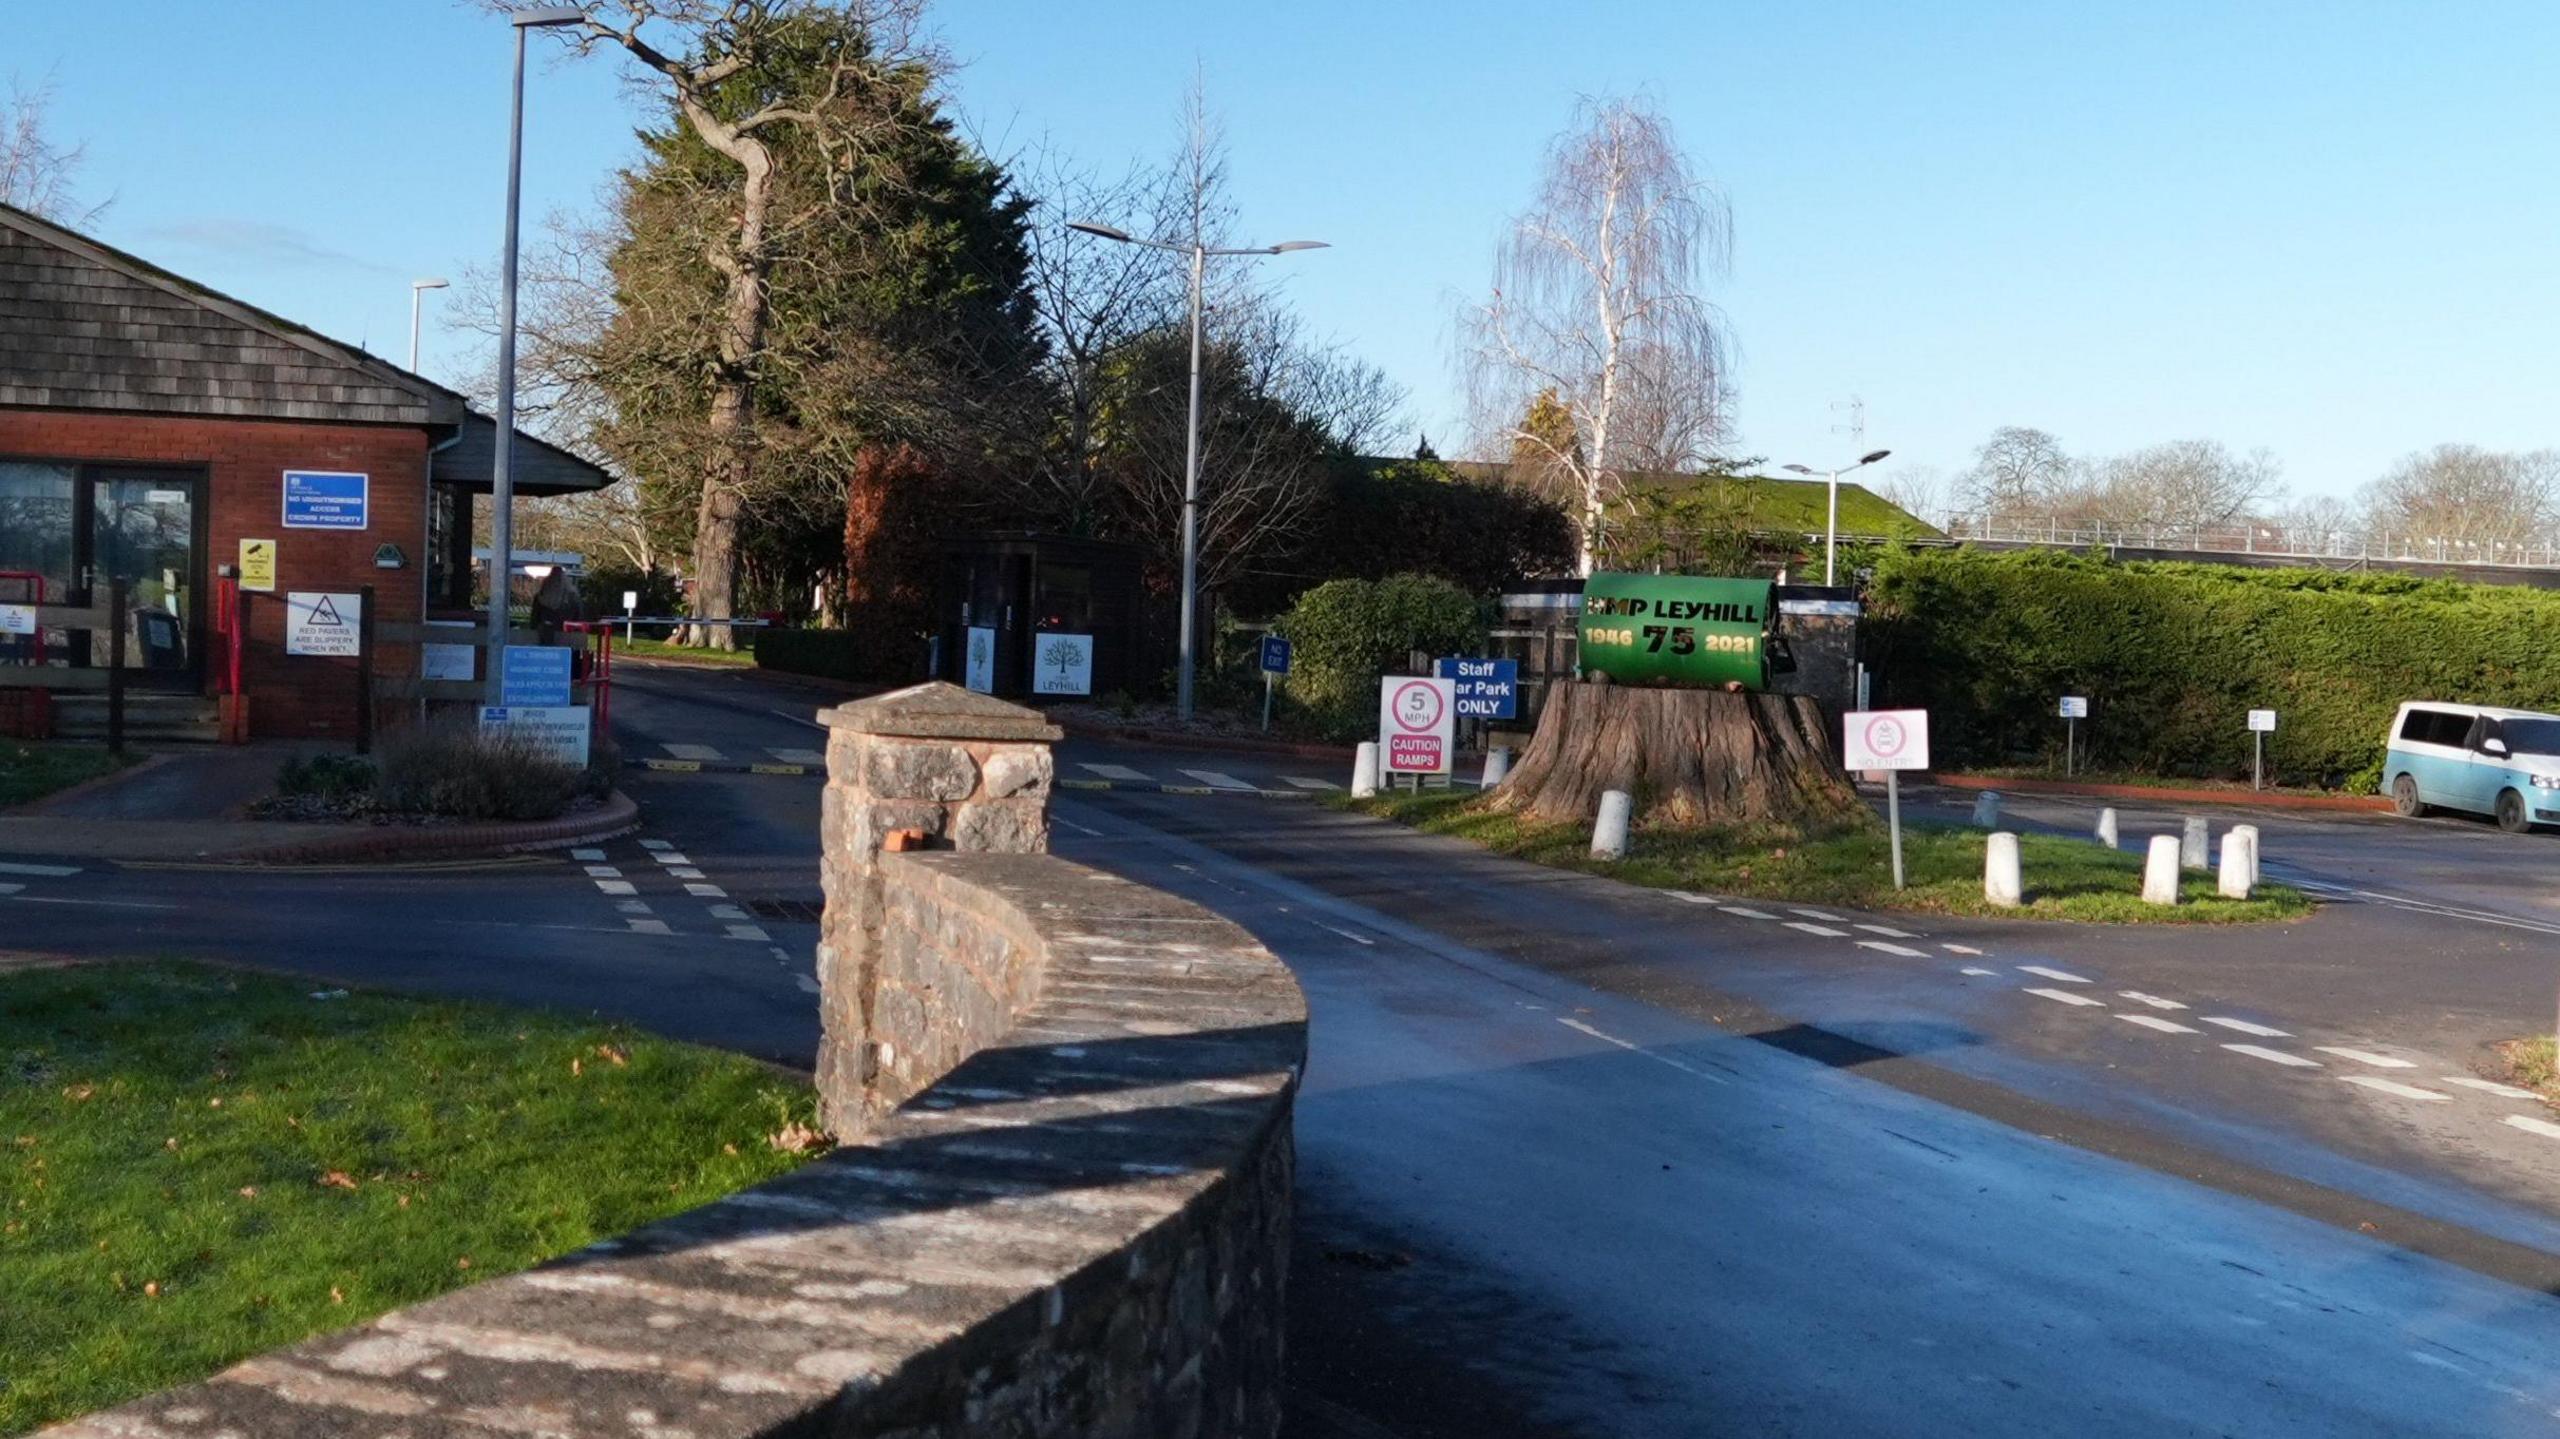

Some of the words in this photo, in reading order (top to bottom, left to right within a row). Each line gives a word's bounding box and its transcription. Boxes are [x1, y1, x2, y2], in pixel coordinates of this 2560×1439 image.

[320, 515, 361, 523] PROPERTY
[1654, 600, 1758, 623] LEYHILL
[295, 636, 312, 644] ARE
[1585, 628, 1633, 646] 1946
[1643, 625, 1696, 656] 75
[1705, 634, 1755, 653] 2021
[1271, 644, 1282, 655] NO
[1268, 655, 1282, 666] EXIT
[1458, 662, 1495, 676] Staff
[1043, 680, 1081, 691] LEYHILL
[1456, 684, 1472, 694] ar
[1475, 682, 1510, 696] Park
[1410, 692, 1425, 711] 5
[1457, 699, 1500, 714] ONLY
[1404, 712, 1430, 723] MPH
[1392, 739, 1440, 751] CAUTION
[1396, 754, 1434, 766] RAMPS
